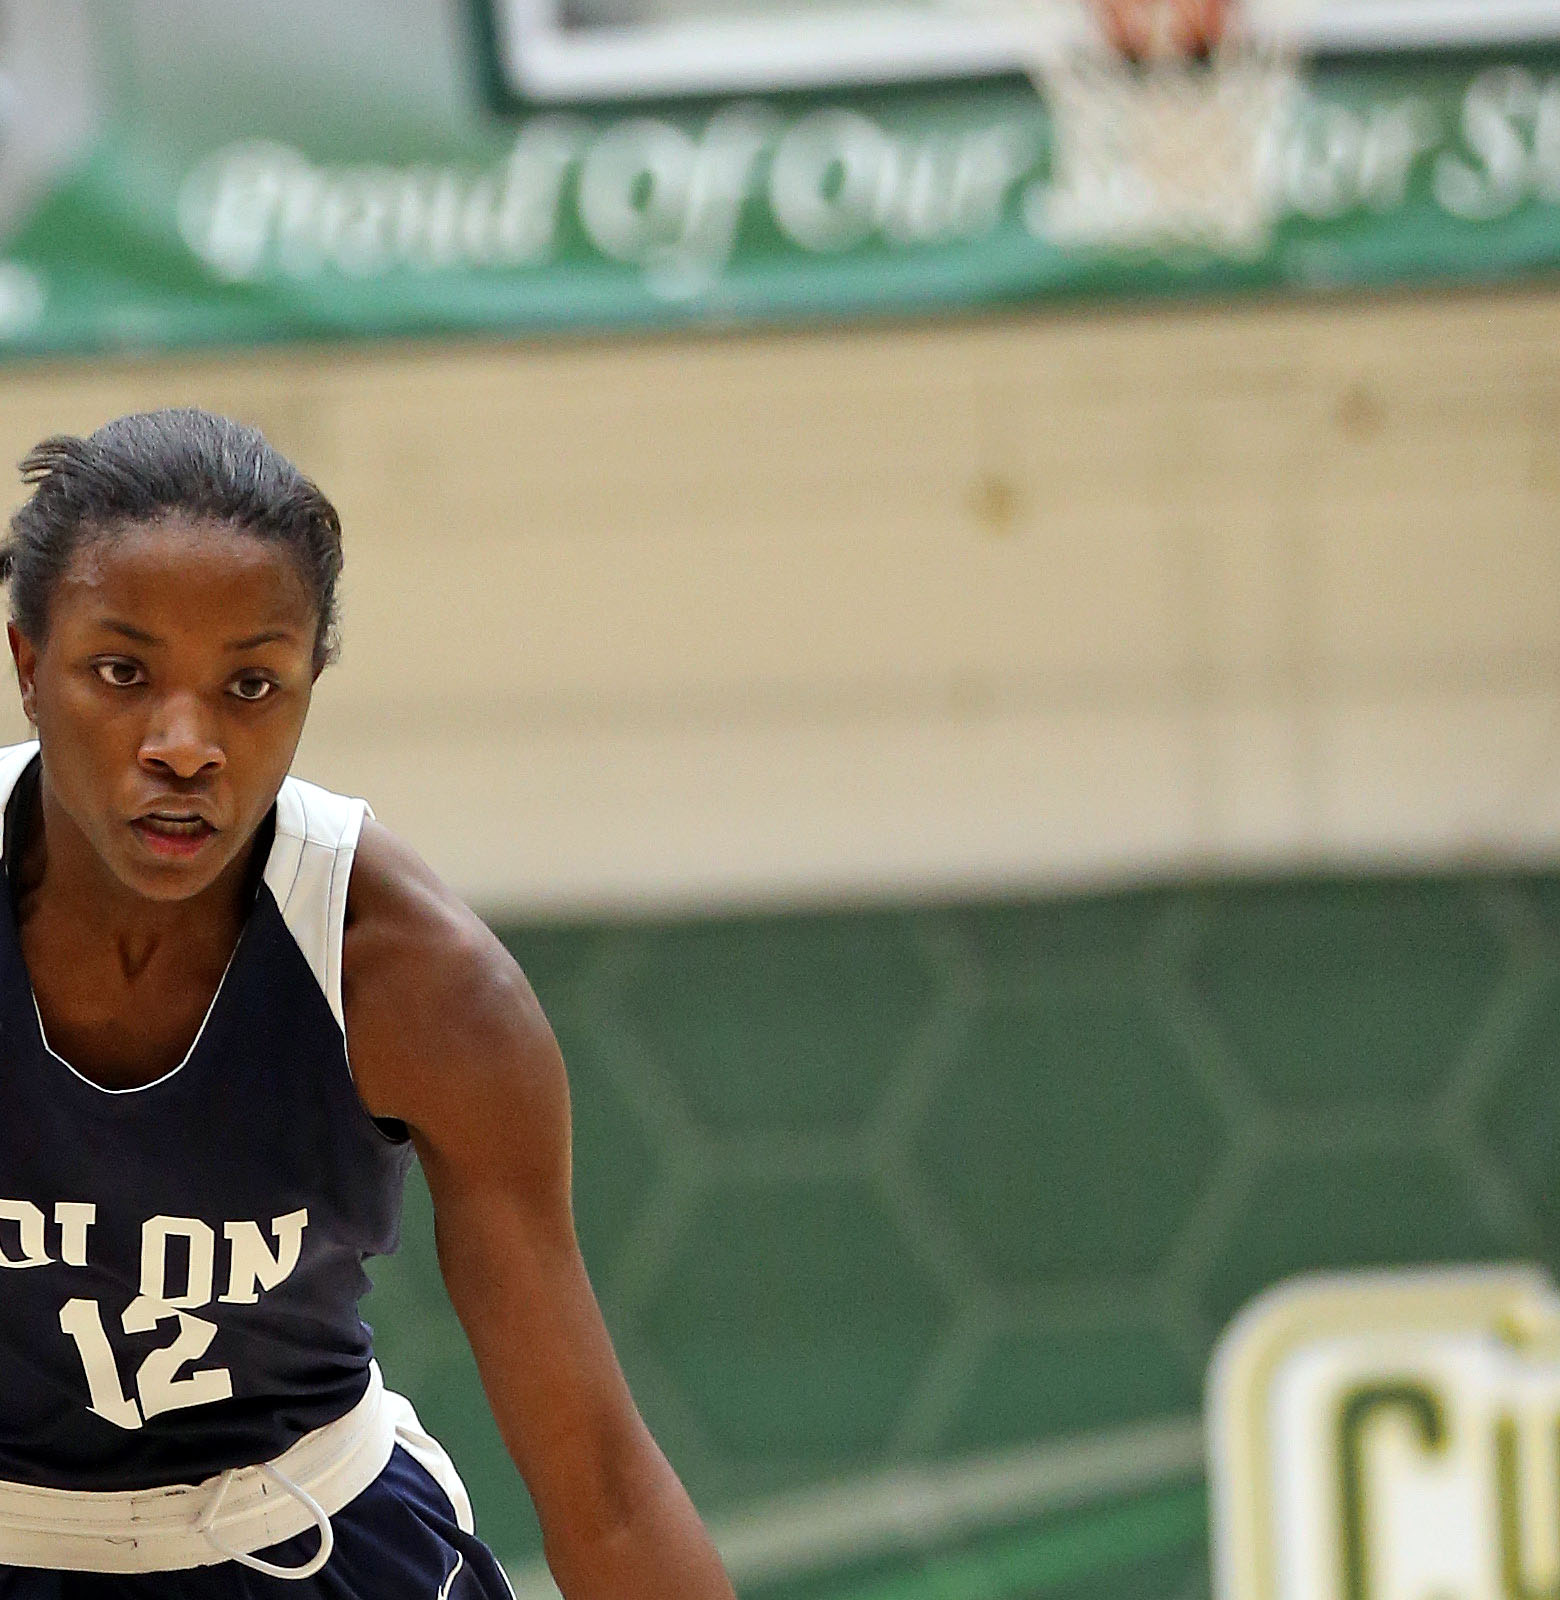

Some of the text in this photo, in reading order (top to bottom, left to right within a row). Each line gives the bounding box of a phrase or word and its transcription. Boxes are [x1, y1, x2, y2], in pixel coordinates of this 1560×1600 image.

[182, 118, 582, 282] Proud
[770, 108, 1032, 252] Our
[59, 1297, 233, 1429] 12
